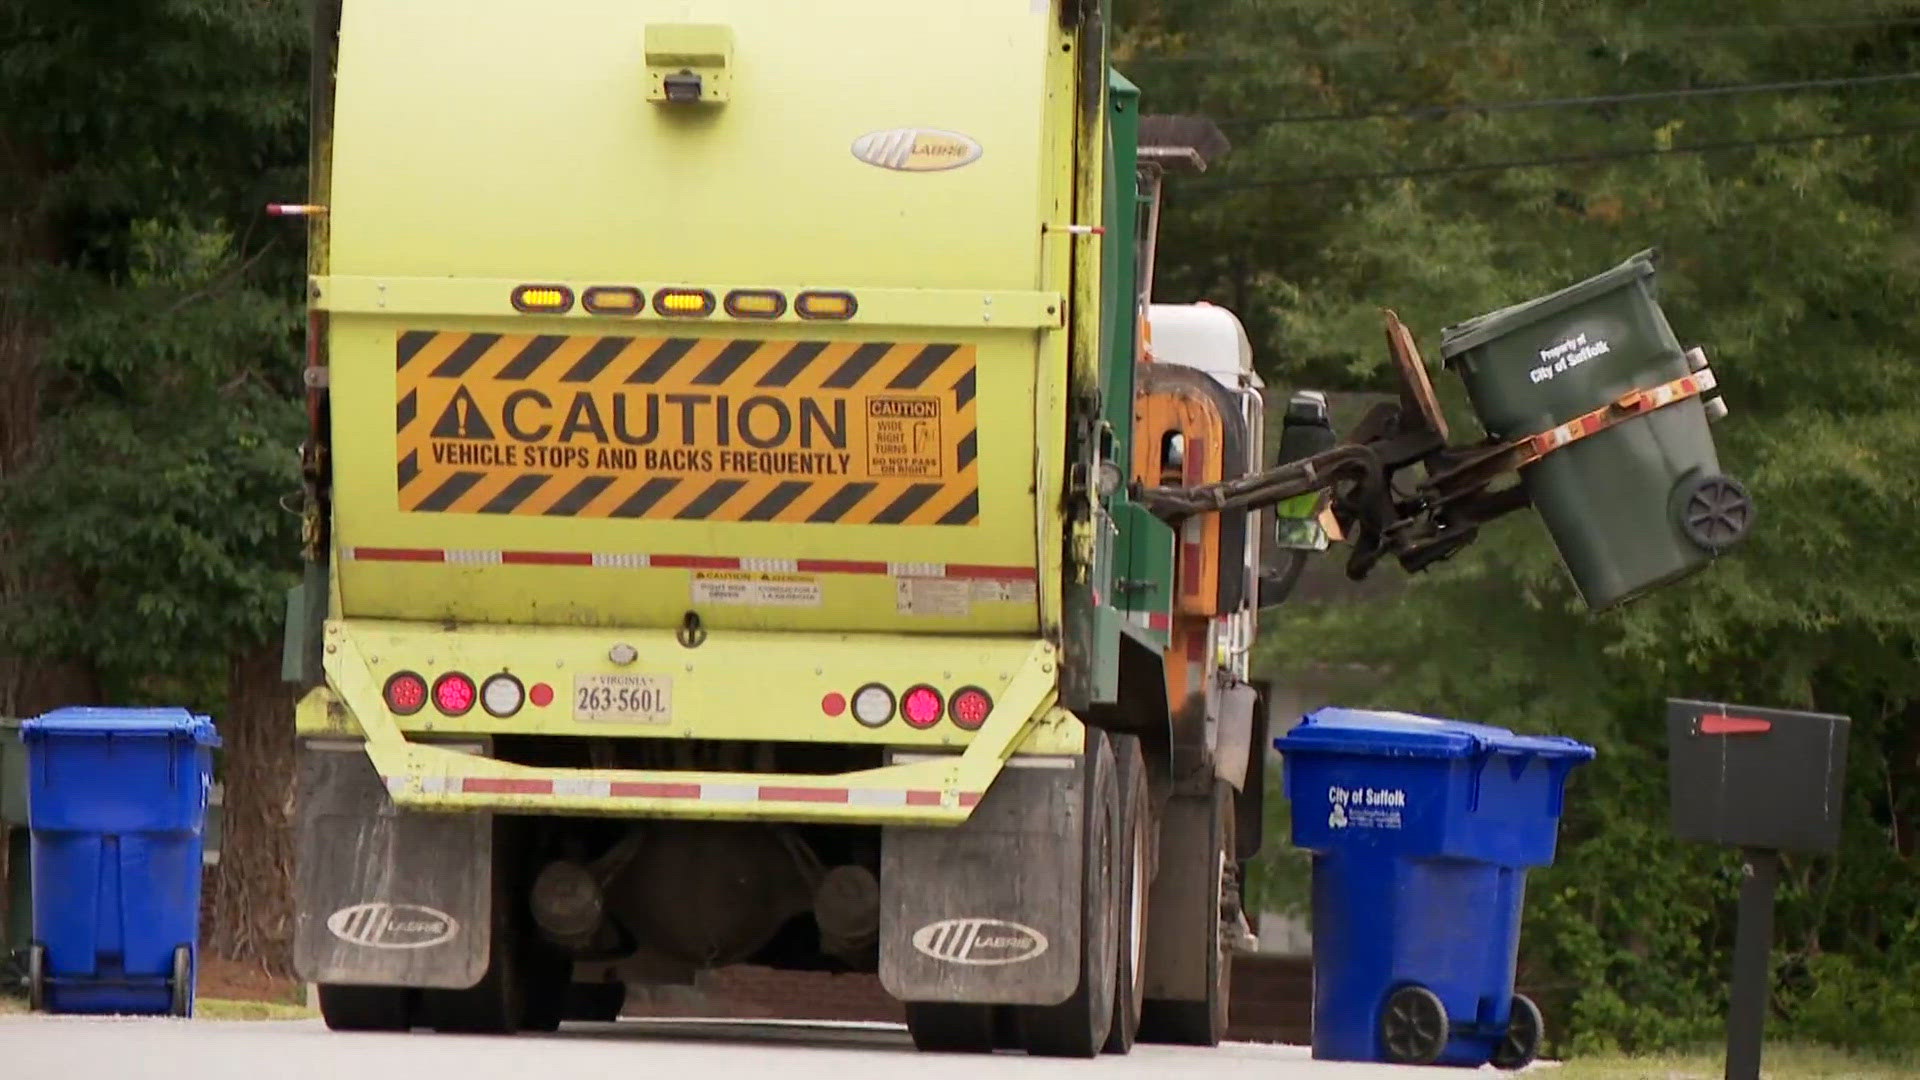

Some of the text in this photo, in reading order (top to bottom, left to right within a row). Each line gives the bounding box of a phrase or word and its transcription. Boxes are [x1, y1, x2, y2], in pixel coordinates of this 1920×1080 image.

[1530, 341, 1610, 384] City of Suffolk
[872, 402, 935, 415] CAUTION
[502, 388, 847, 449] CAUTION
[877, 420, 902, 431] WIDE
[876, 433, 905, 443] RIGHT
[875, 443, 908, 454] TURNS
[432, 442, 850, 475] VEHICLE STOPS AND BACKS FREQUENTLY
[872, 457, 887, 466] DO
[888, 457, 908, 466] NOT
[706, 571, 752, 581] CAUTION
[600, 675, 647, 686] VIRGINIA
[1329, 786, 1405, 807] City of Suffolk
